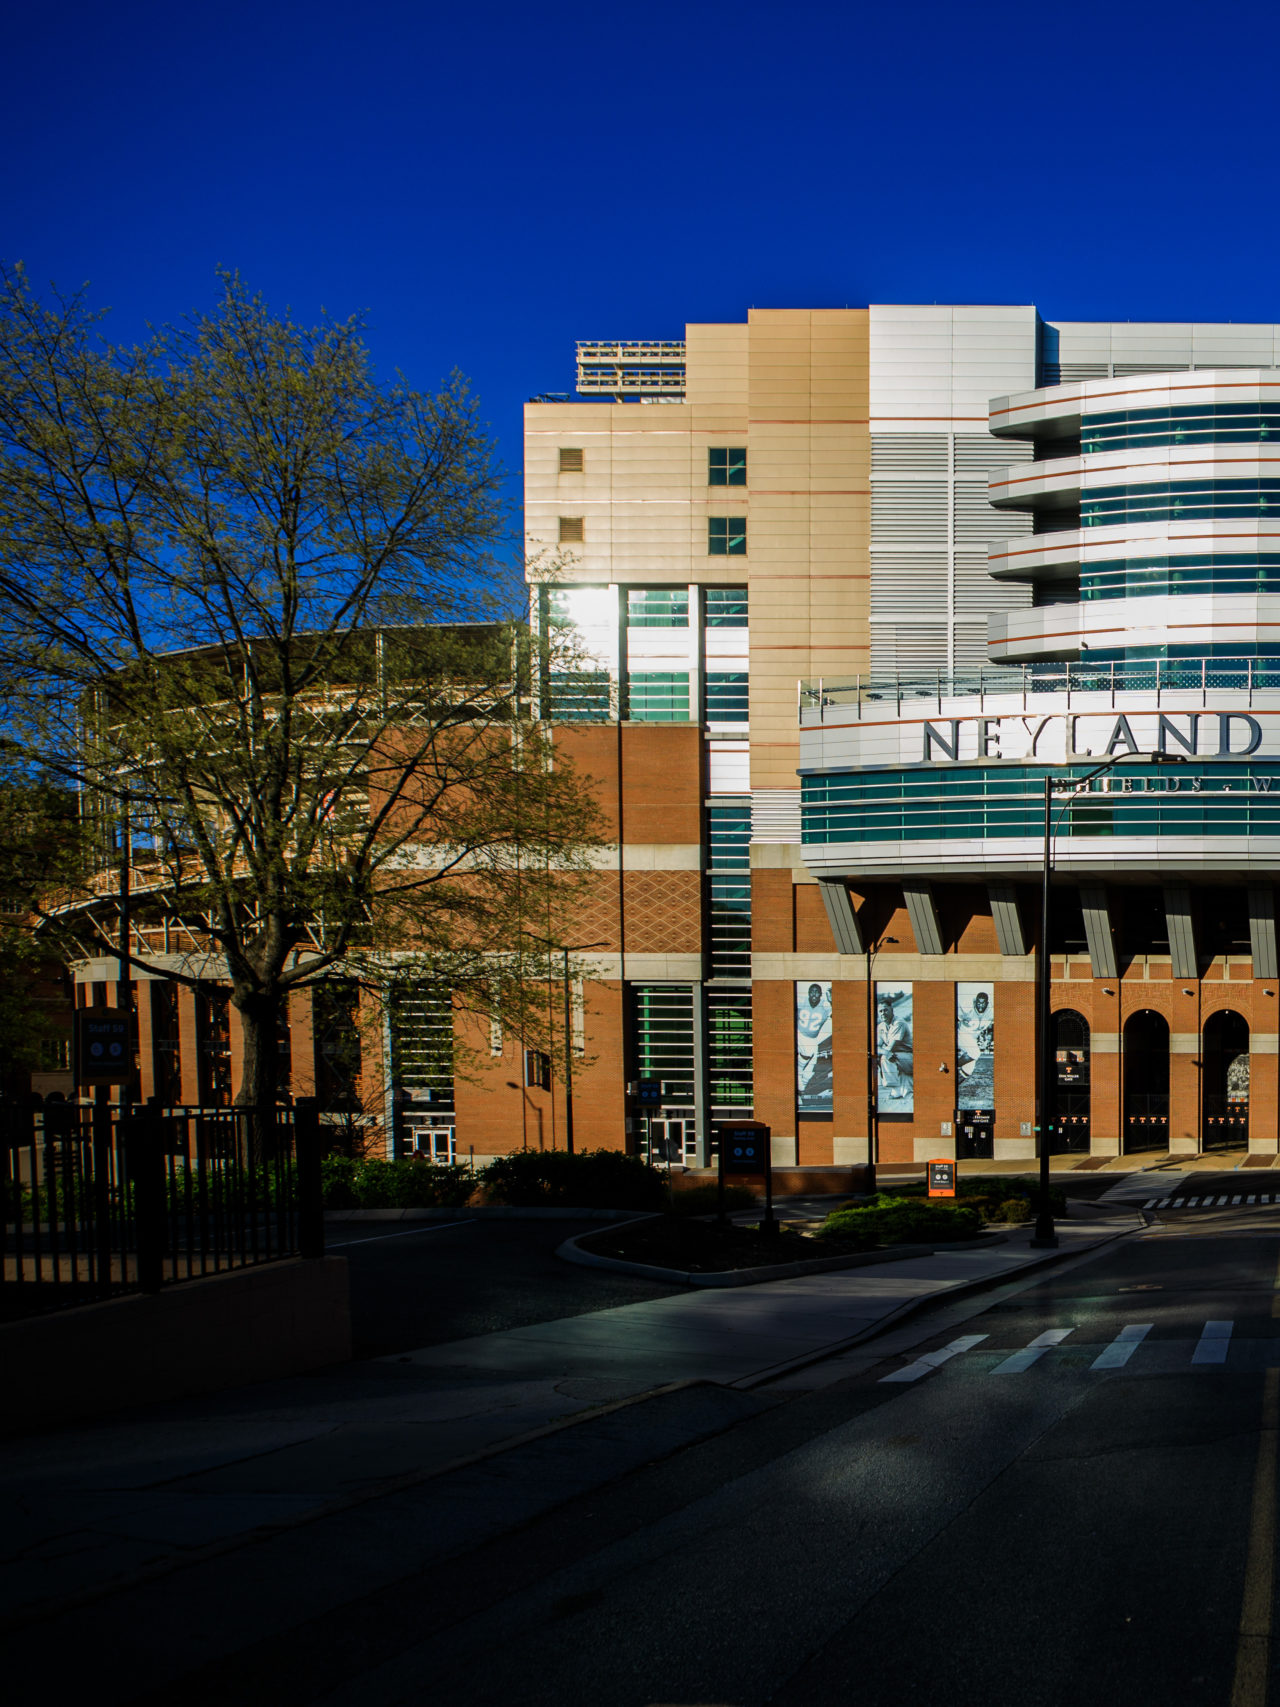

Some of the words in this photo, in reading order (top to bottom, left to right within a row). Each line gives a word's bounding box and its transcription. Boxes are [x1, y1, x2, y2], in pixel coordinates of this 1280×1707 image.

[923, 713, 1264, 763] NEYLAND
[1056, 776, 1203, 794] SHIELDS
[799, 1010, 822, 1031] 92
